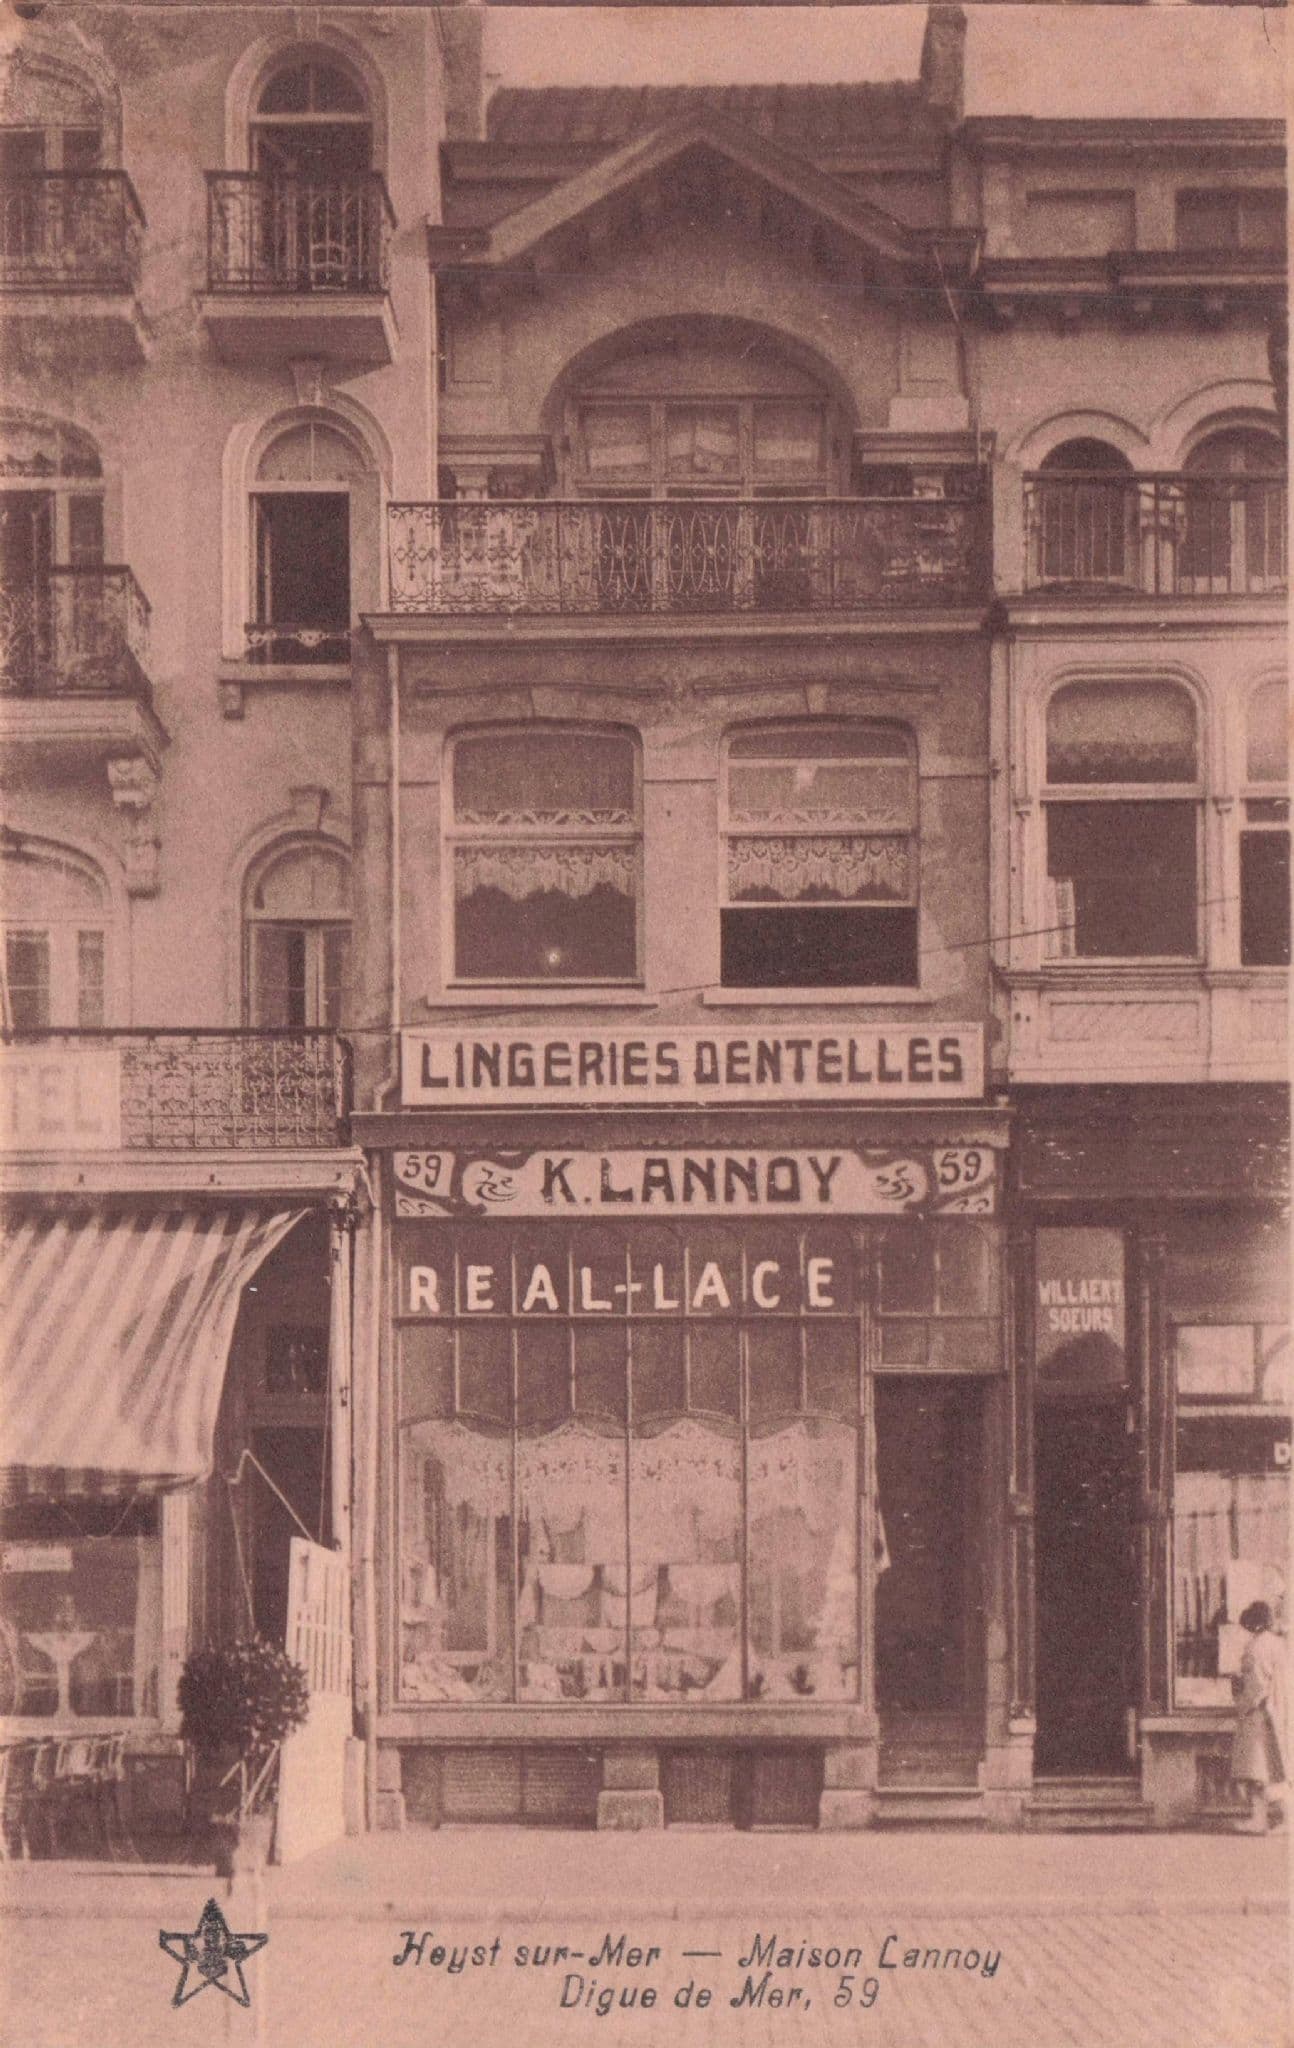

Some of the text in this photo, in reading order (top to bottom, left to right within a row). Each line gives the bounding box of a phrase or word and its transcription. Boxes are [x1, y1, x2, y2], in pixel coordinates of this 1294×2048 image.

[421, 1038, 963, 1088] LINGERIES DENTELLES
[403, 1154, 442, 1188] 59
[939, 1151, 982, 1186] 59
[1049, 1307, 1113, 1333] SOEURS
